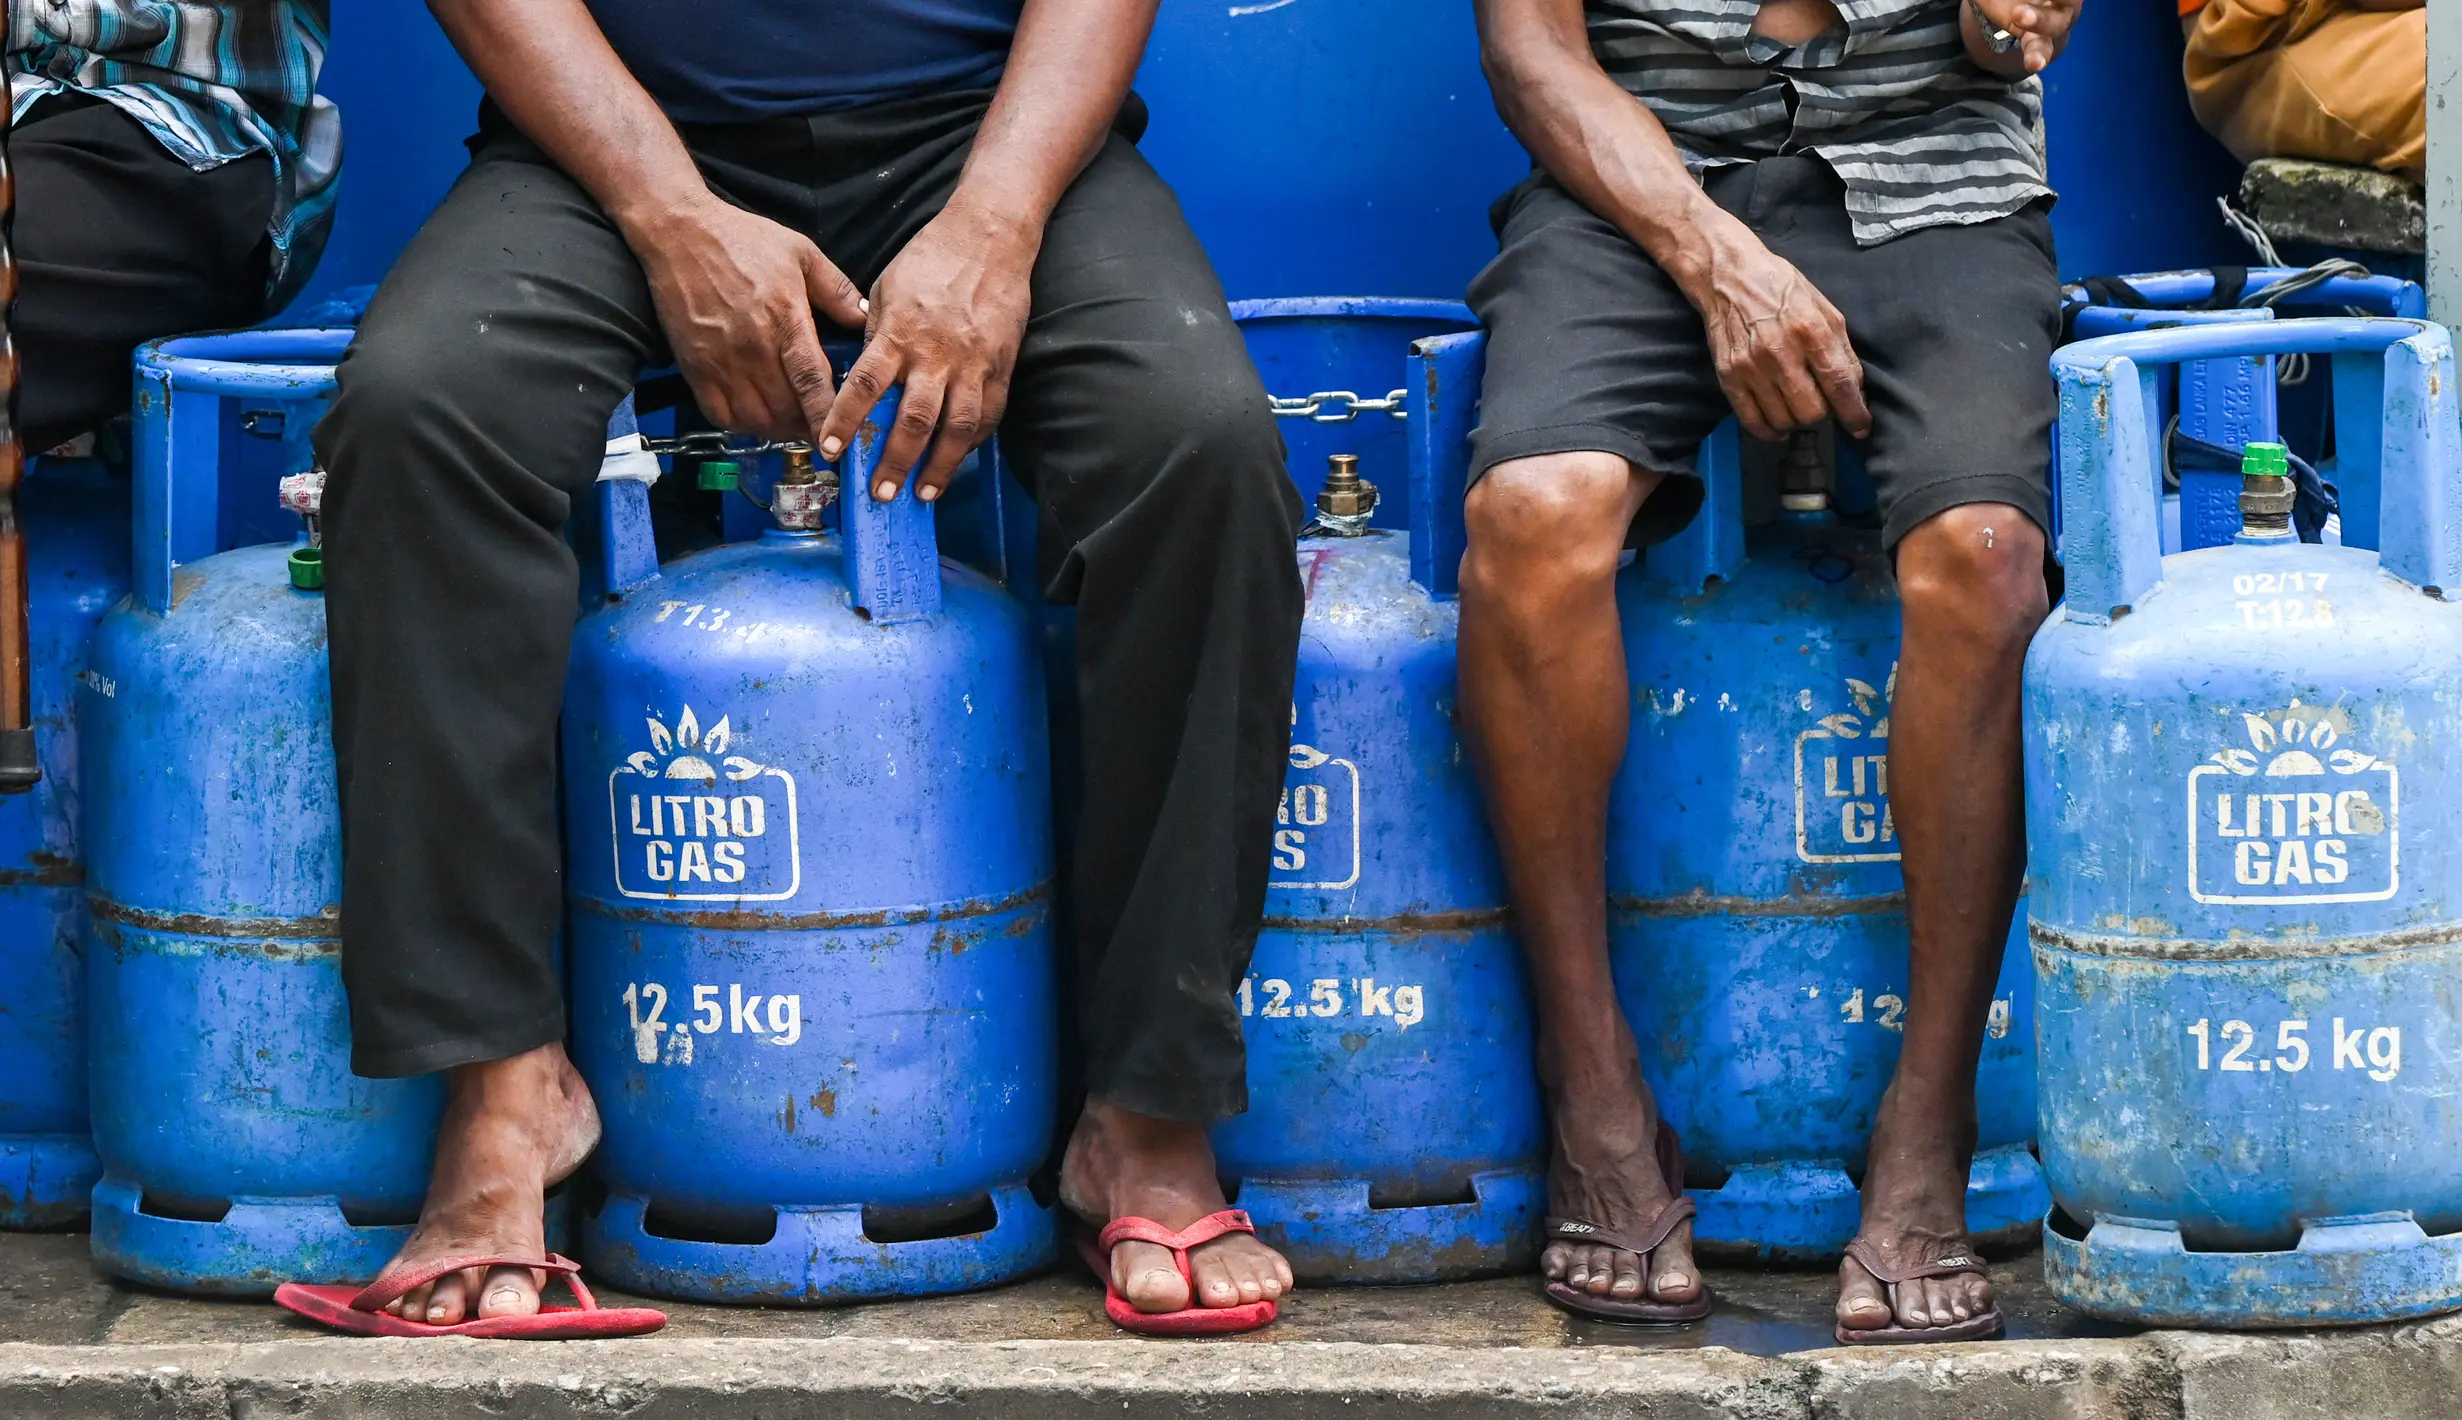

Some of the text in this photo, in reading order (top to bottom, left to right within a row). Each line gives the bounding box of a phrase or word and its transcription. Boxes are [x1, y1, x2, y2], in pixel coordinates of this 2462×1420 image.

[2233, 571, 2330, 596] 02/17
[102, 675, 116, 699] Vol
[1824, 755, 1888, 797] LIT
[630, 794, 766, 838] LITRO
[2217, 790, 2386, 838] LITRO
[646, 840, 746, 883] GAS
[2235, 839, 2349, 886] GAS
[623, 982, 723, 1034] 12.5
[730, 983, 801, 1046] kg
[1236, 977, 1425, 1031] 12.5 kg
[1840, 987, 2010, 1039] 12 g
[2187, 1017, 2401, 1082] 12.5 kg
